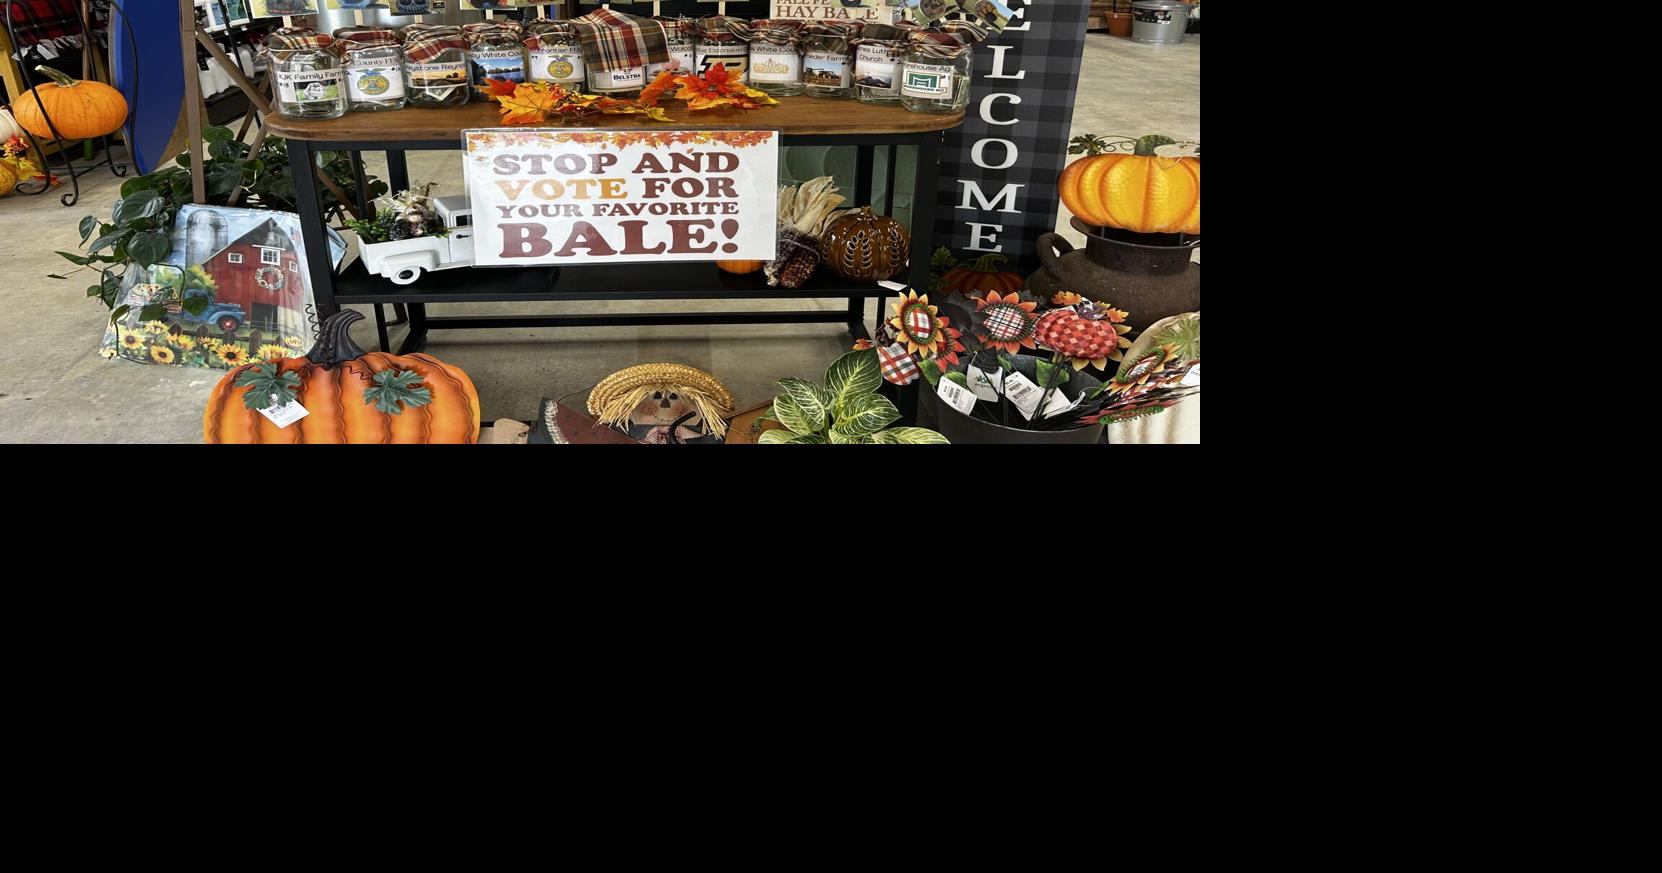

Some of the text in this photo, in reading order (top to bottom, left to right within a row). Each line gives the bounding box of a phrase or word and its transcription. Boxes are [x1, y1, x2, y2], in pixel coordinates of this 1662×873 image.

[775, 5, 879, 20] HAY BAE
[294, 71, 324, 81] Family
[493, 151, 740, 176] STOP AND
[494, 177, 740, 201] VOTE FOR
[495, 201, 740, 219] YOUR FAVORITE
[497, 218, 740, 259] BALE!
